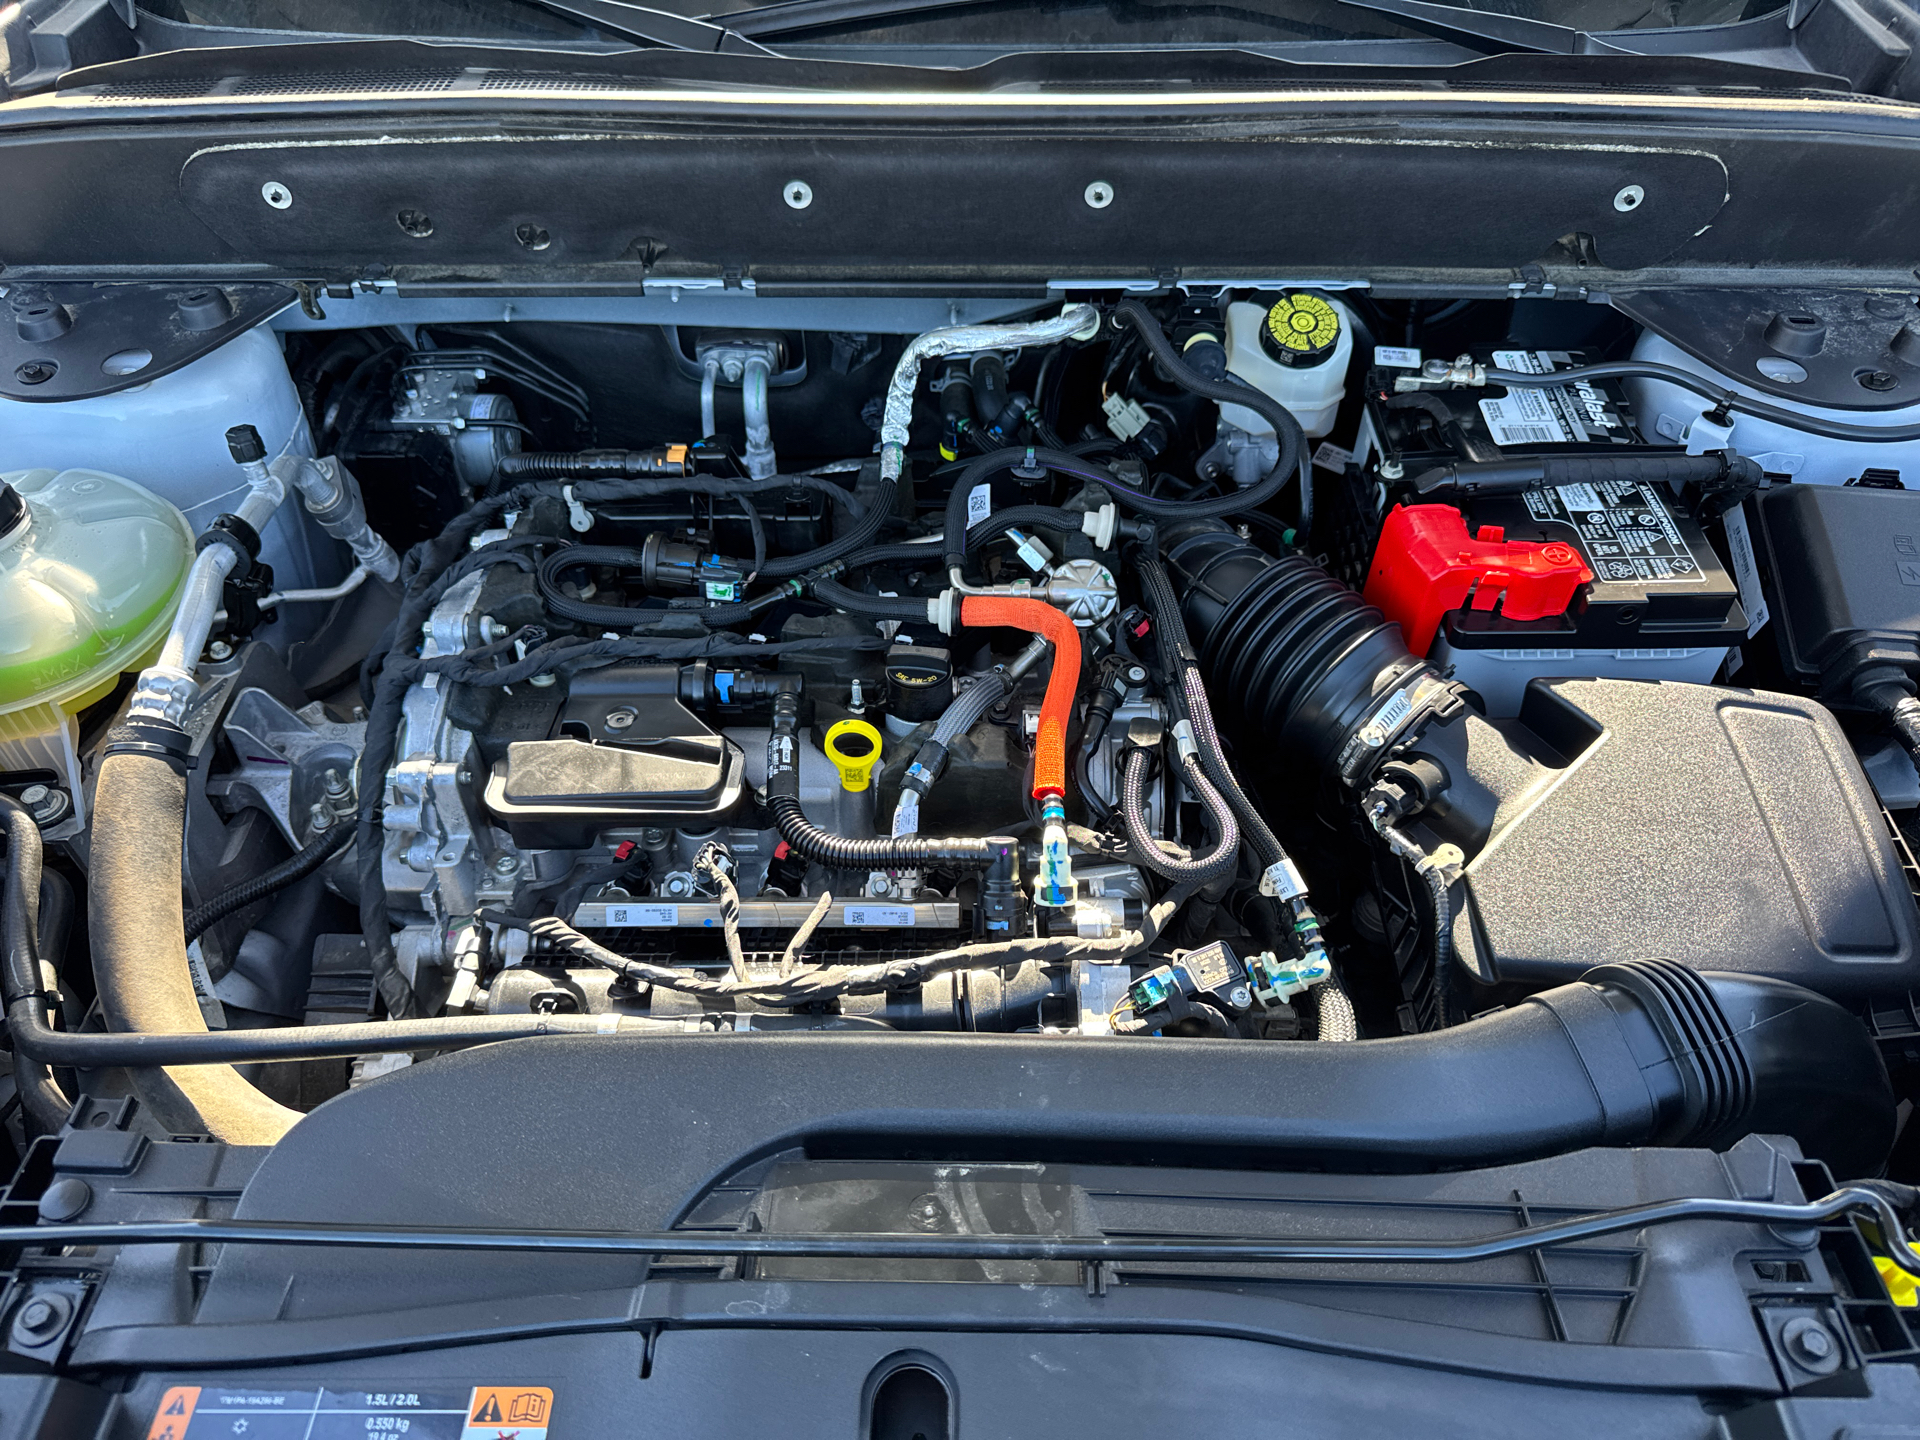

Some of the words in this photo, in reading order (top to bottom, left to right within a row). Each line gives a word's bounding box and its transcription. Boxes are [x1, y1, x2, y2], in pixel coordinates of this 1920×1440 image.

[1567, 388, 1593, 427] PLATINUM
[1571, 376, 1617, 429] uralast
[1642, 491, 1682, 545] DANGER/POISON
[1601, 545, 1612, 554] NOT
[40, 654, 90, 683] MAX
[895, 672, 909, 682] SAE
[911, 675, 938, 684] 5W-20
[365, 1393, 389, 1406] 1.5L
[396, 1393, 421, 1406] 2.0L
[365, 1417, 395, 1431] 0.550
[395, 1417, 410, 1433] kg
[368, 1432, 387, 1440] 194
